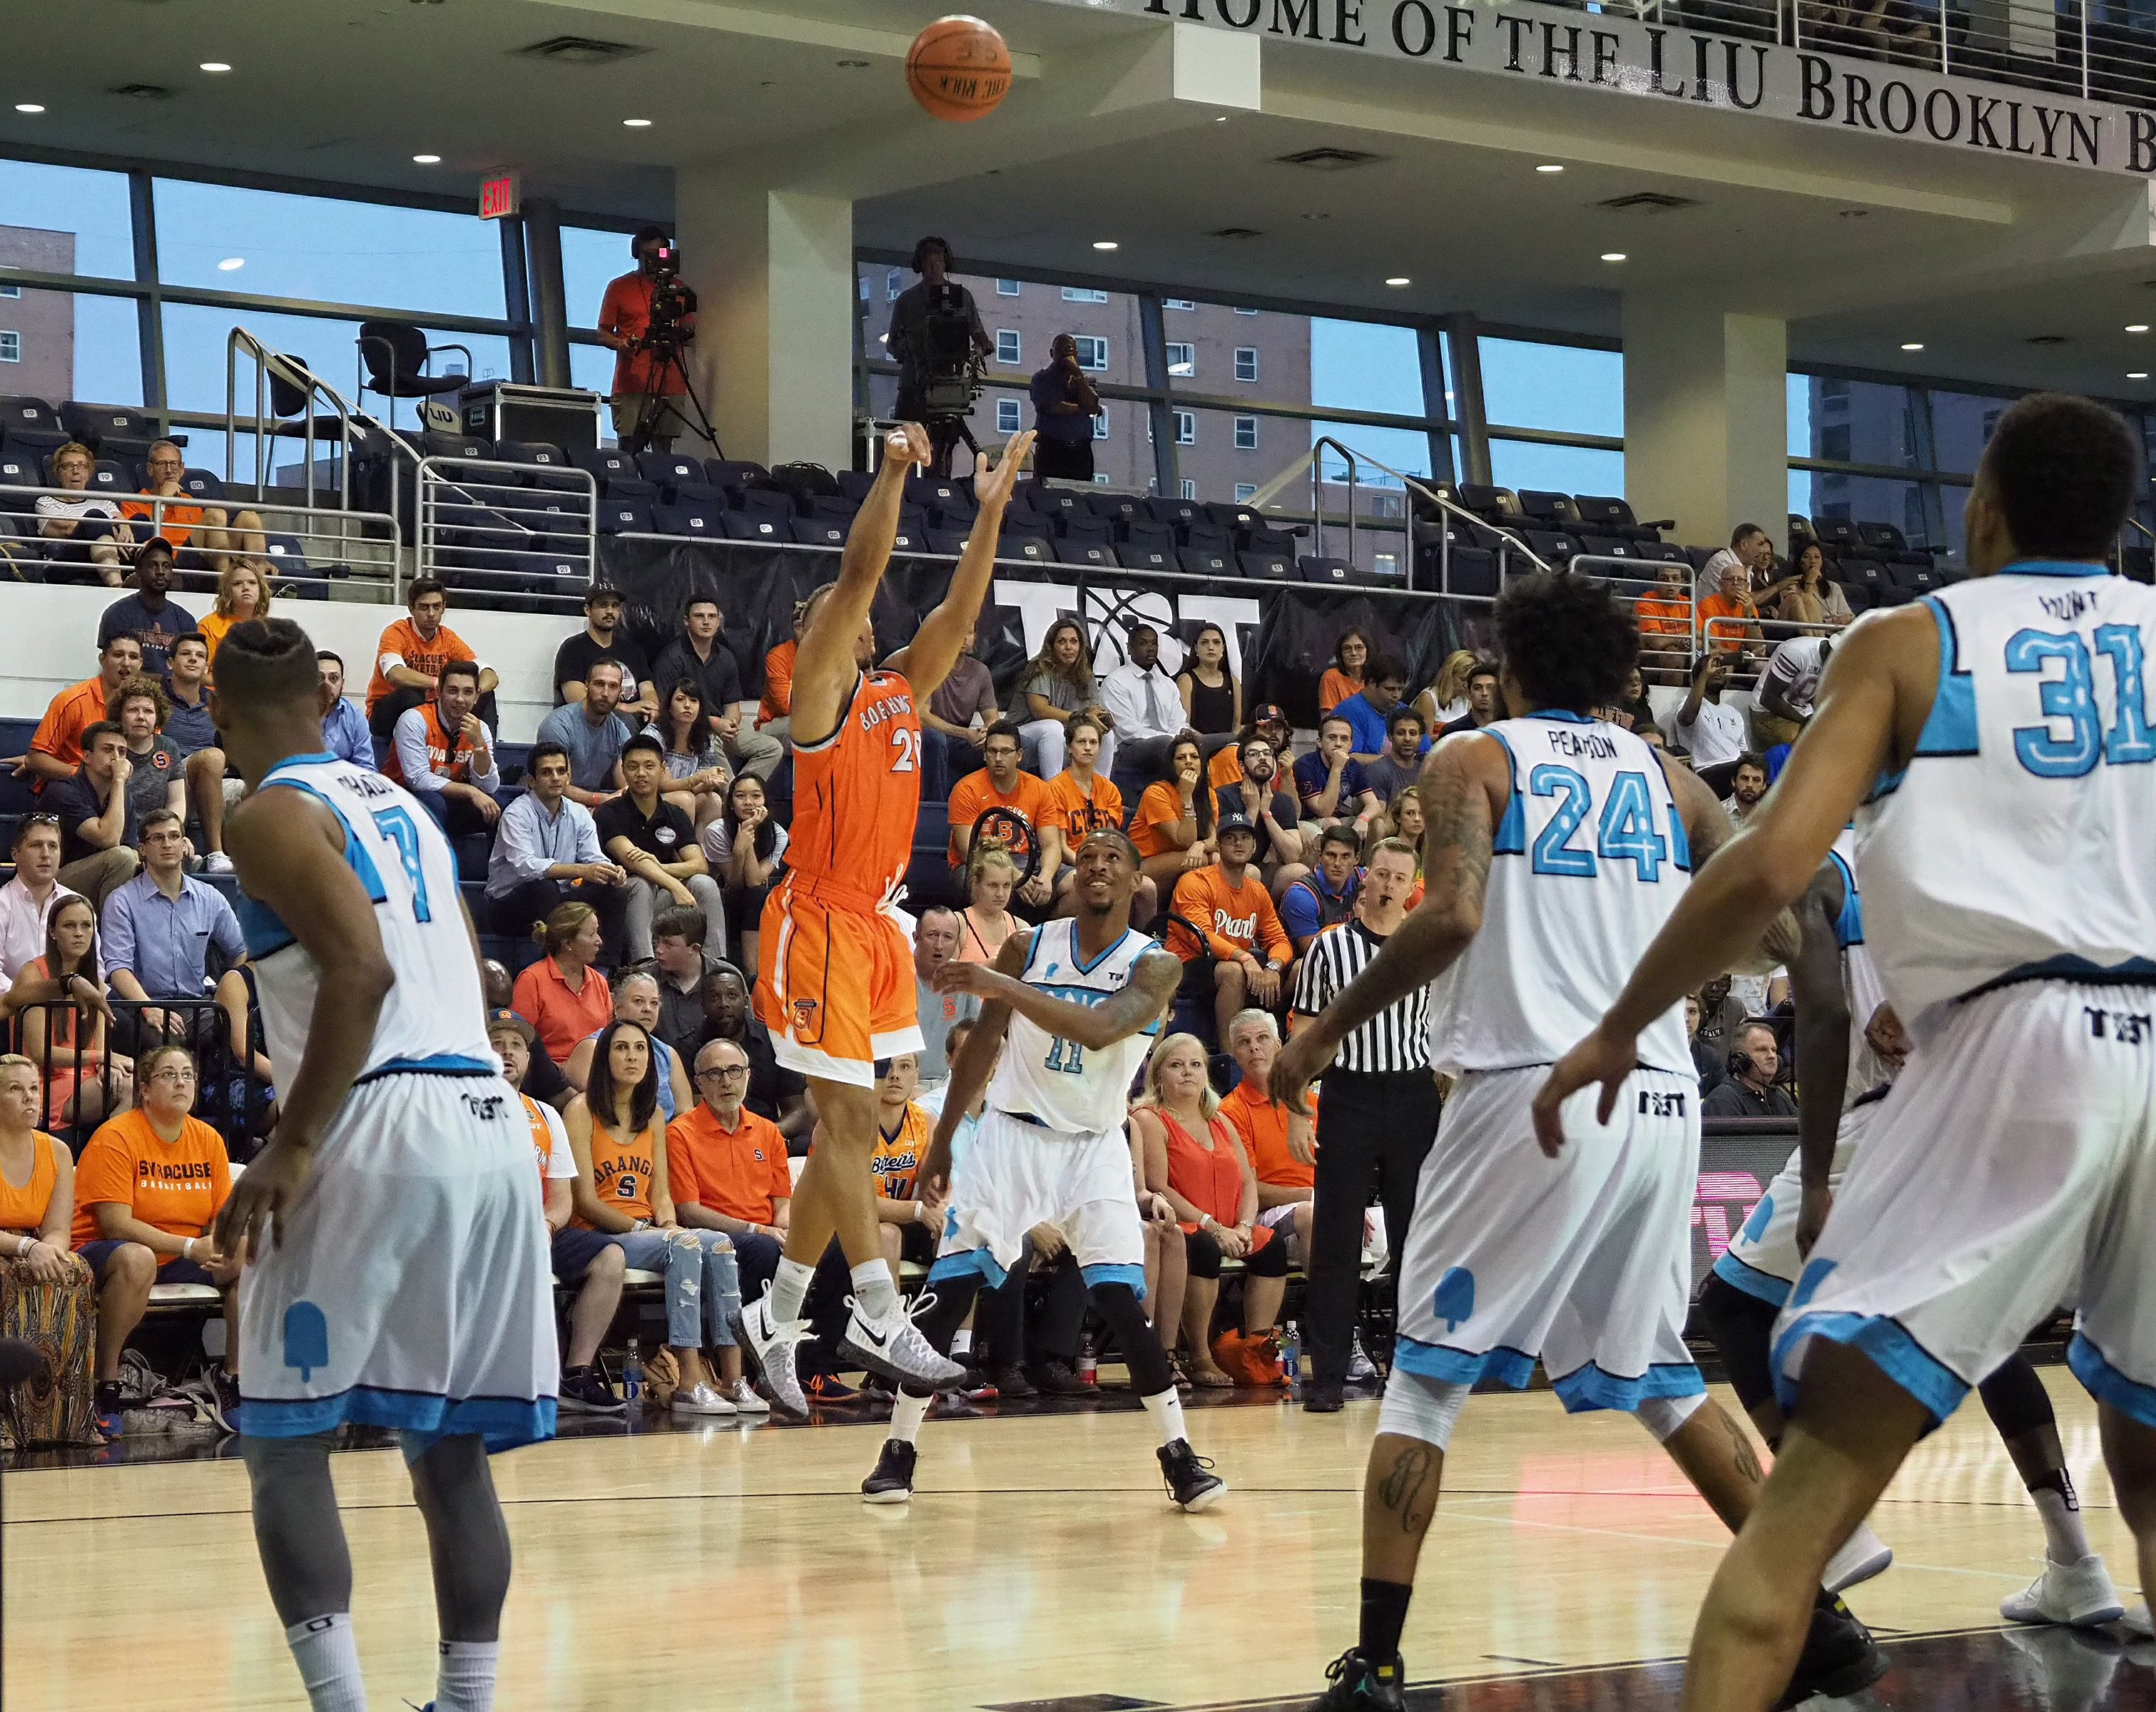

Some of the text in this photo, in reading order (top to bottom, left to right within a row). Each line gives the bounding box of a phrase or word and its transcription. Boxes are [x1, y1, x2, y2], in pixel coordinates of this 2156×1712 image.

[1391, 0, 1475, 63] OF
[1496, 13, 1619, 87] THE
[1644, 27, 1769, 109] LIU
[1796, 54, 2102, 165] BROOKLYN
[483, 178, 511, 216] EXIT
[429, 407, 453, 423] LIU
[2005, 623, 2156, 778] 31
[1232, 812, 1244, 822] NY
[1530, 763, 1667, 882] 24
[998, 820, 1012, 841] S
[370, 805, 432, 923] 7
[942, 996, 957, 1016] S
[753, 1148, 764, 1161] S
[138, 1160, 211, 1180] SYRACUSE
[595, 1156, 654, 1184] ORANG
[616, 1174, 637, 1198] S
